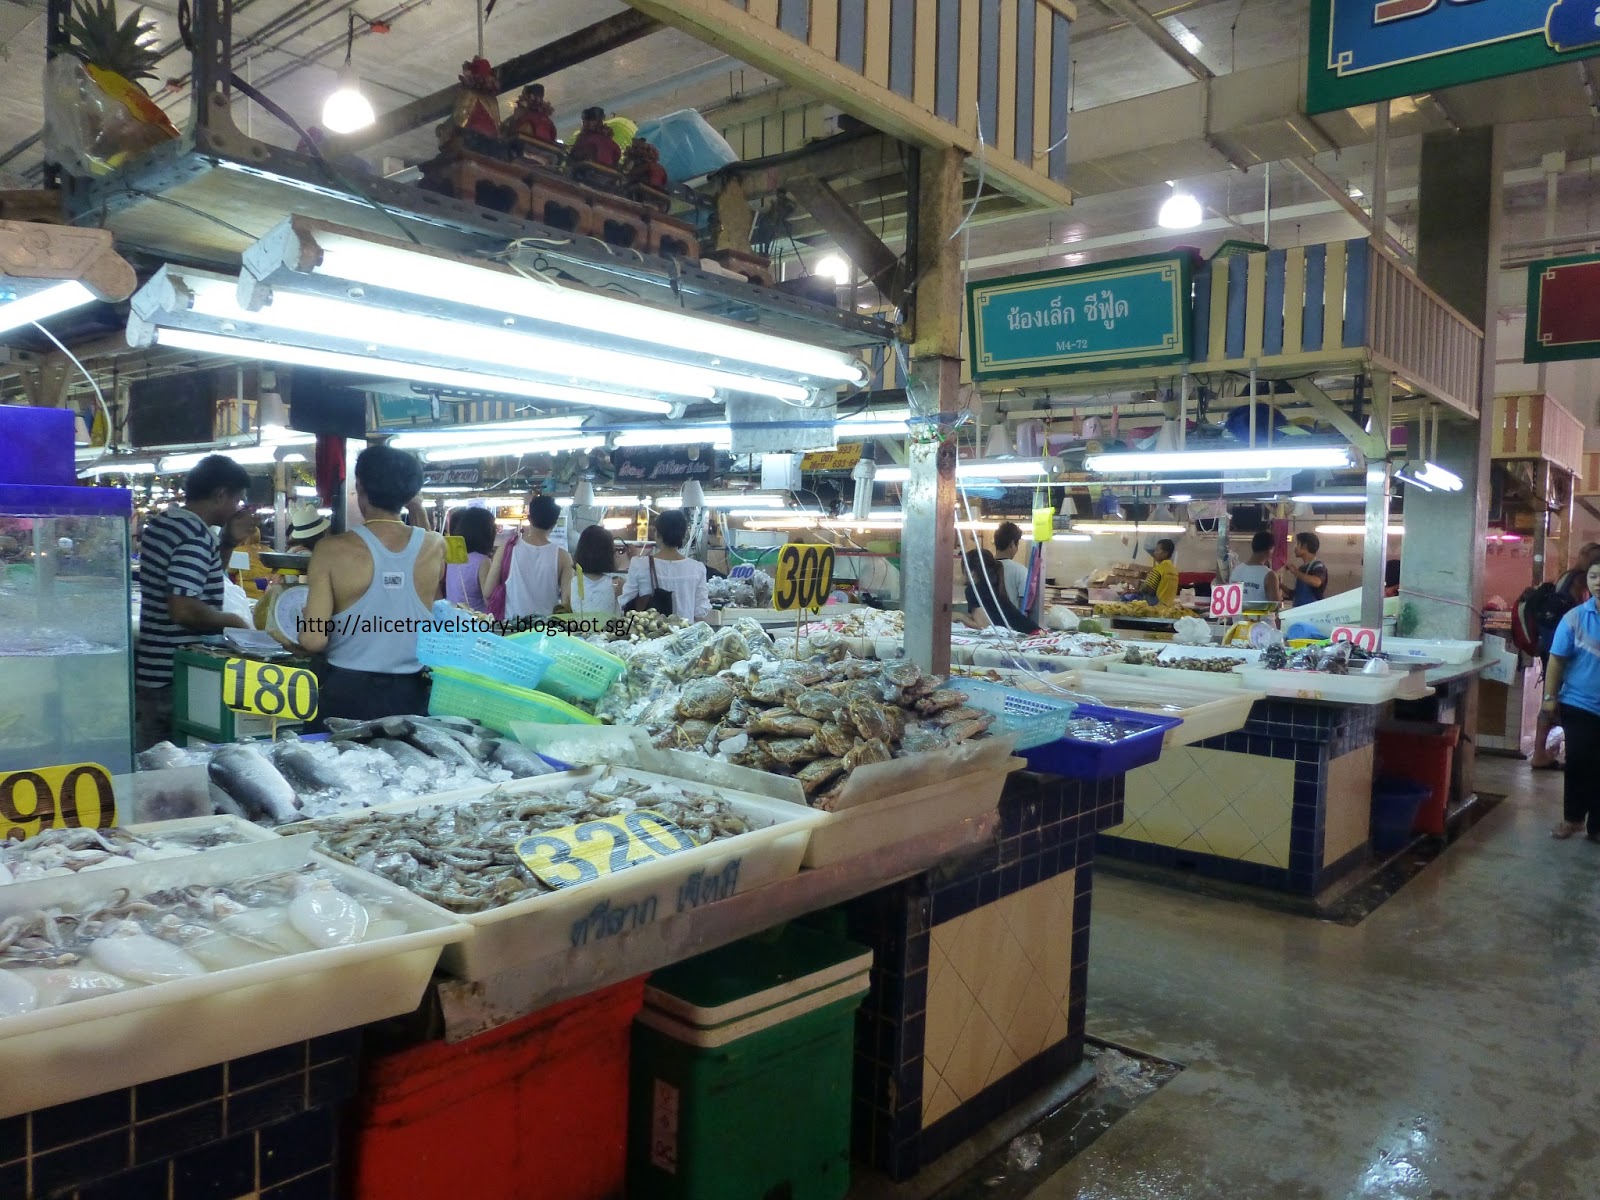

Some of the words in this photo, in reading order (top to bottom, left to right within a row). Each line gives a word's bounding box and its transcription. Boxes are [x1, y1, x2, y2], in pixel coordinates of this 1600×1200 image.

[1007, 295, 1075, 330] น้องเล็ก
[1083, 290, 1129, 330] ซีฟู้ด
[1056, 339, 1088, 352] M4-72
[732, 566, 754, 578] 100
[777, 546, 835, 609] 300
[1211, 585, 1241, 617] 80
[226, 658, 318, 721] 180
[0, 766, 115, 840] 90
[519, 811, 697, 890] 320
